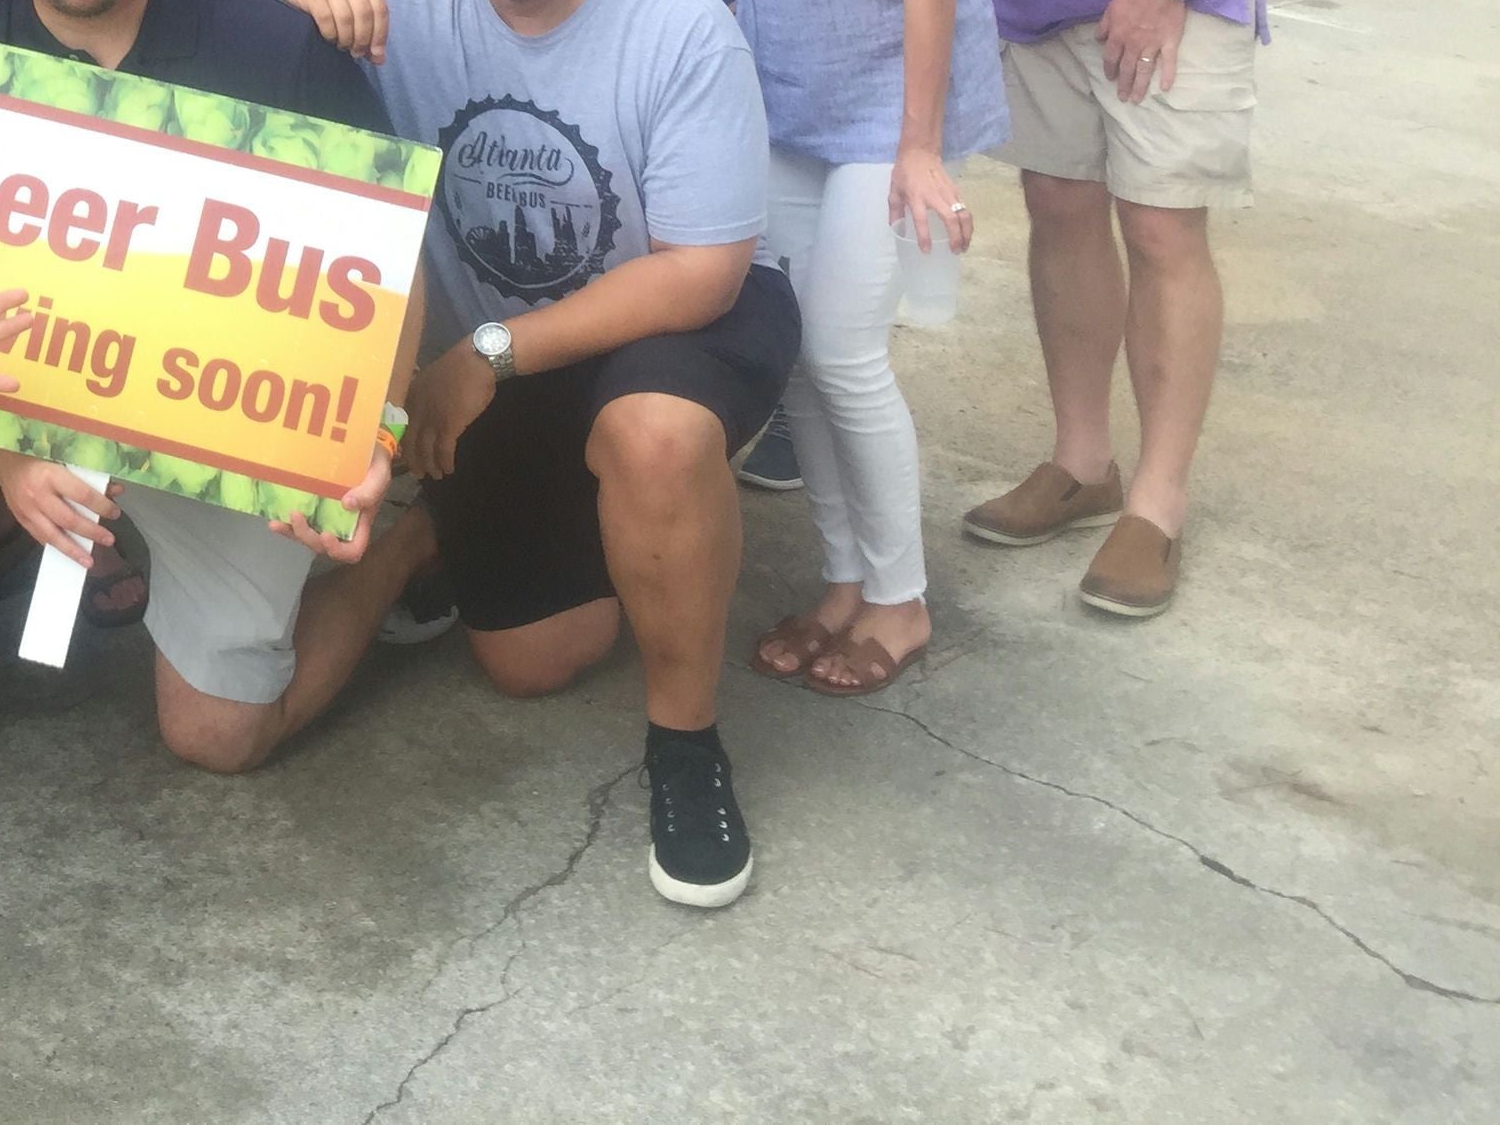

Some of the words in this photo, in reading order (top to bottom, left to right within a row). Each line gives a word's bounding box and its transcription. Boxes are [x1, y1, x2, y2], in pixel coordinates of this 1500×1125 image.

[457, 130, 562, 172] Atlanta
[183, 196, 382, 333] Bus
[156, 346, 360, 444] soon!
